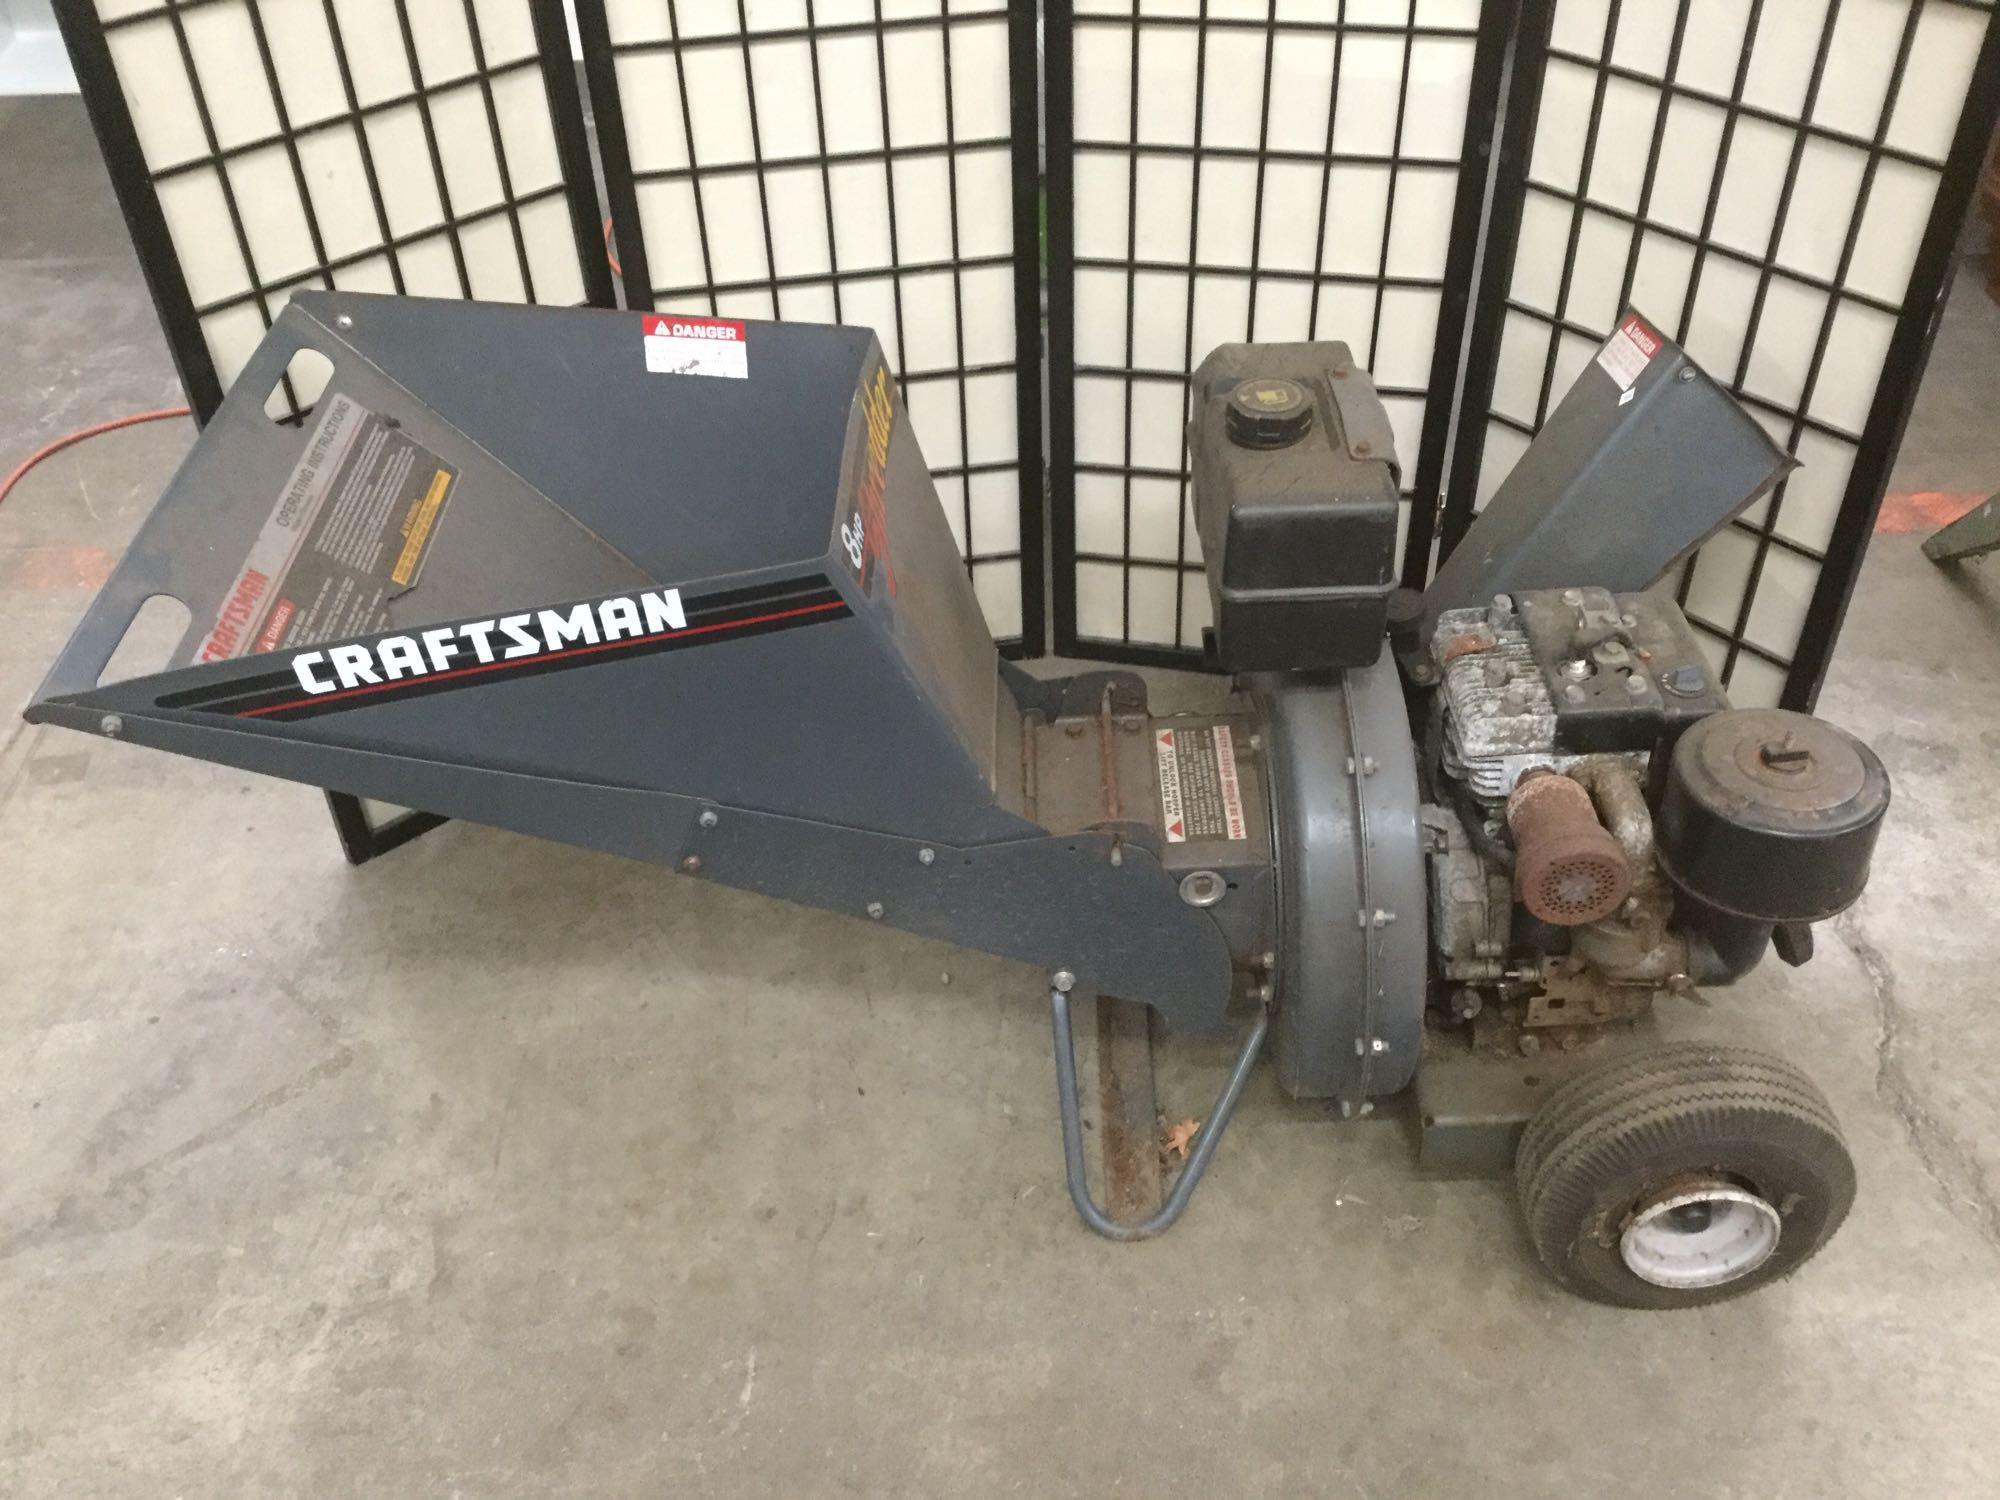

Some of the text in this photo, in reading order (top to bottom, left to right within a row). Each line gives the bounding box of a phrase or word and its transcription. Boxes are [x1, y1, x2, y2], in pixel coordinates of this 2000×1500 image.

[673, 324, 737, 340] DANGER
[1629, 326, 1657, 356] DANGER
[276, 468, 315, 528] OPERATING
[307, 400, 351, 469] INSTRUCTIONS
[267, 606, 290, 639] DANGER
[292, 588, 688, 695] CRAFTSMAN
[1161, 769, 1170, 797] RELEASE
[1167, 760, 1176, 786] UNLOCK
[1170, 789, 1179, 816] HOPPER
